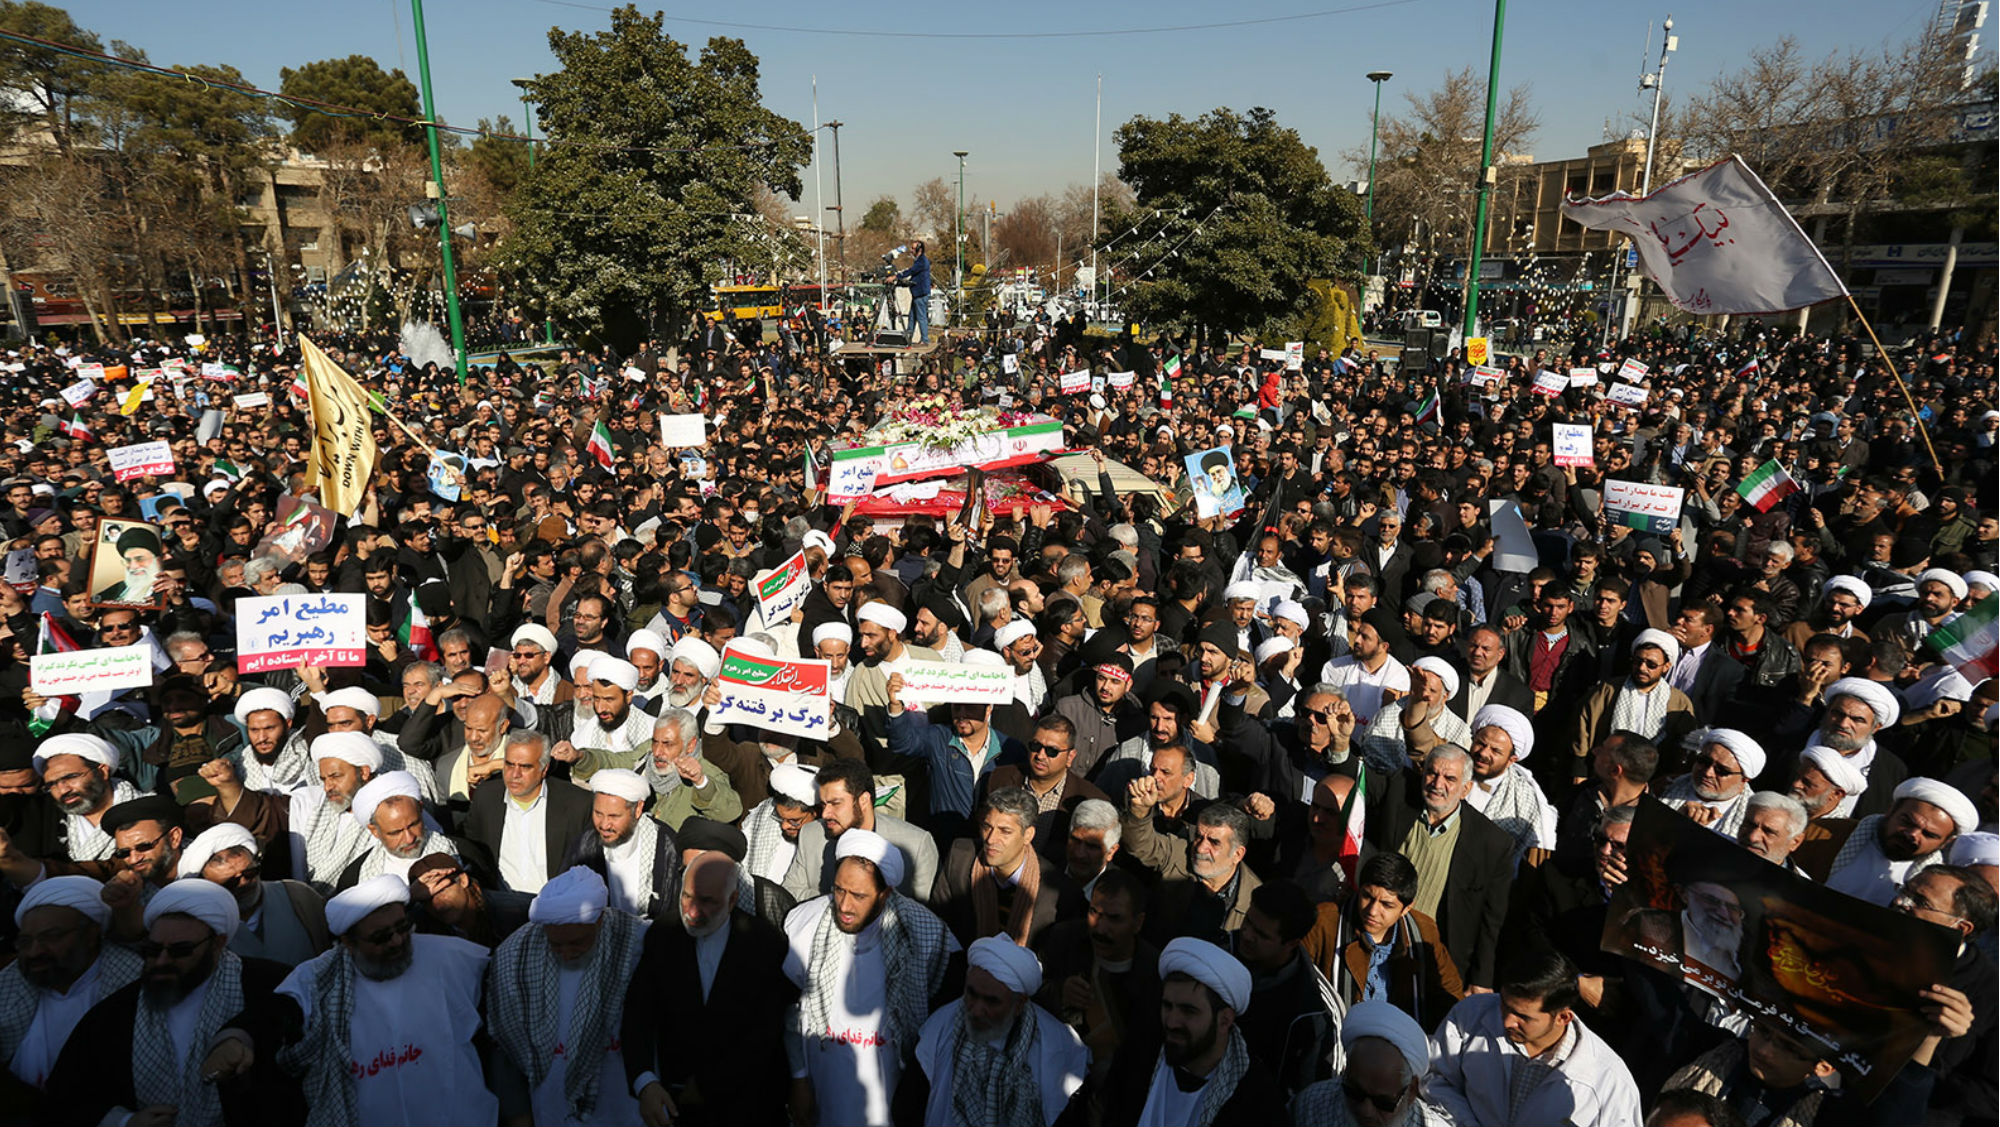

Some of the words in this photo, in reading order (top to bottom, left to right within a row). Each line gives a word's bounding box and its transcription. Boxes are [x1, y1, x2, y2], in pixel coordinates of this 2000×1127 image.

[349, 425, 365, 452] WITH
[342, 453, 358, 489] DOWN
[256, 598, 290, 625] امر
[294, 596, 349, 621] مطیع
[267, 626, 335, 648] رهبریم
[246, 656, 265, 672] ایم
[267, 651, 308, 667] استاده
[311, 650, 337, 666] آخر
[337, 650, 346, 662] تا
[348, 652, 360, 662] ما
[715, 695, 735, 715] گر
[736, 698, 767, 715] فتنه
[769, 708, 784, 723] بر
[788, 706, 824, 729] مرگ
[1727, 987, 1779, 1016] فرمان
[1779, 1012, 1794, 1027] به
[836, 1027, 863, 1047] فدای
[863, 1029, 887, 1052] جانم
[1795, 1021, 1841, 1052] عشق
[367, 1045, 396, 1077] فدای
[397, 1042, 423, 1073] جانم
[1839, 1052, 1872, 1077] لنگر
